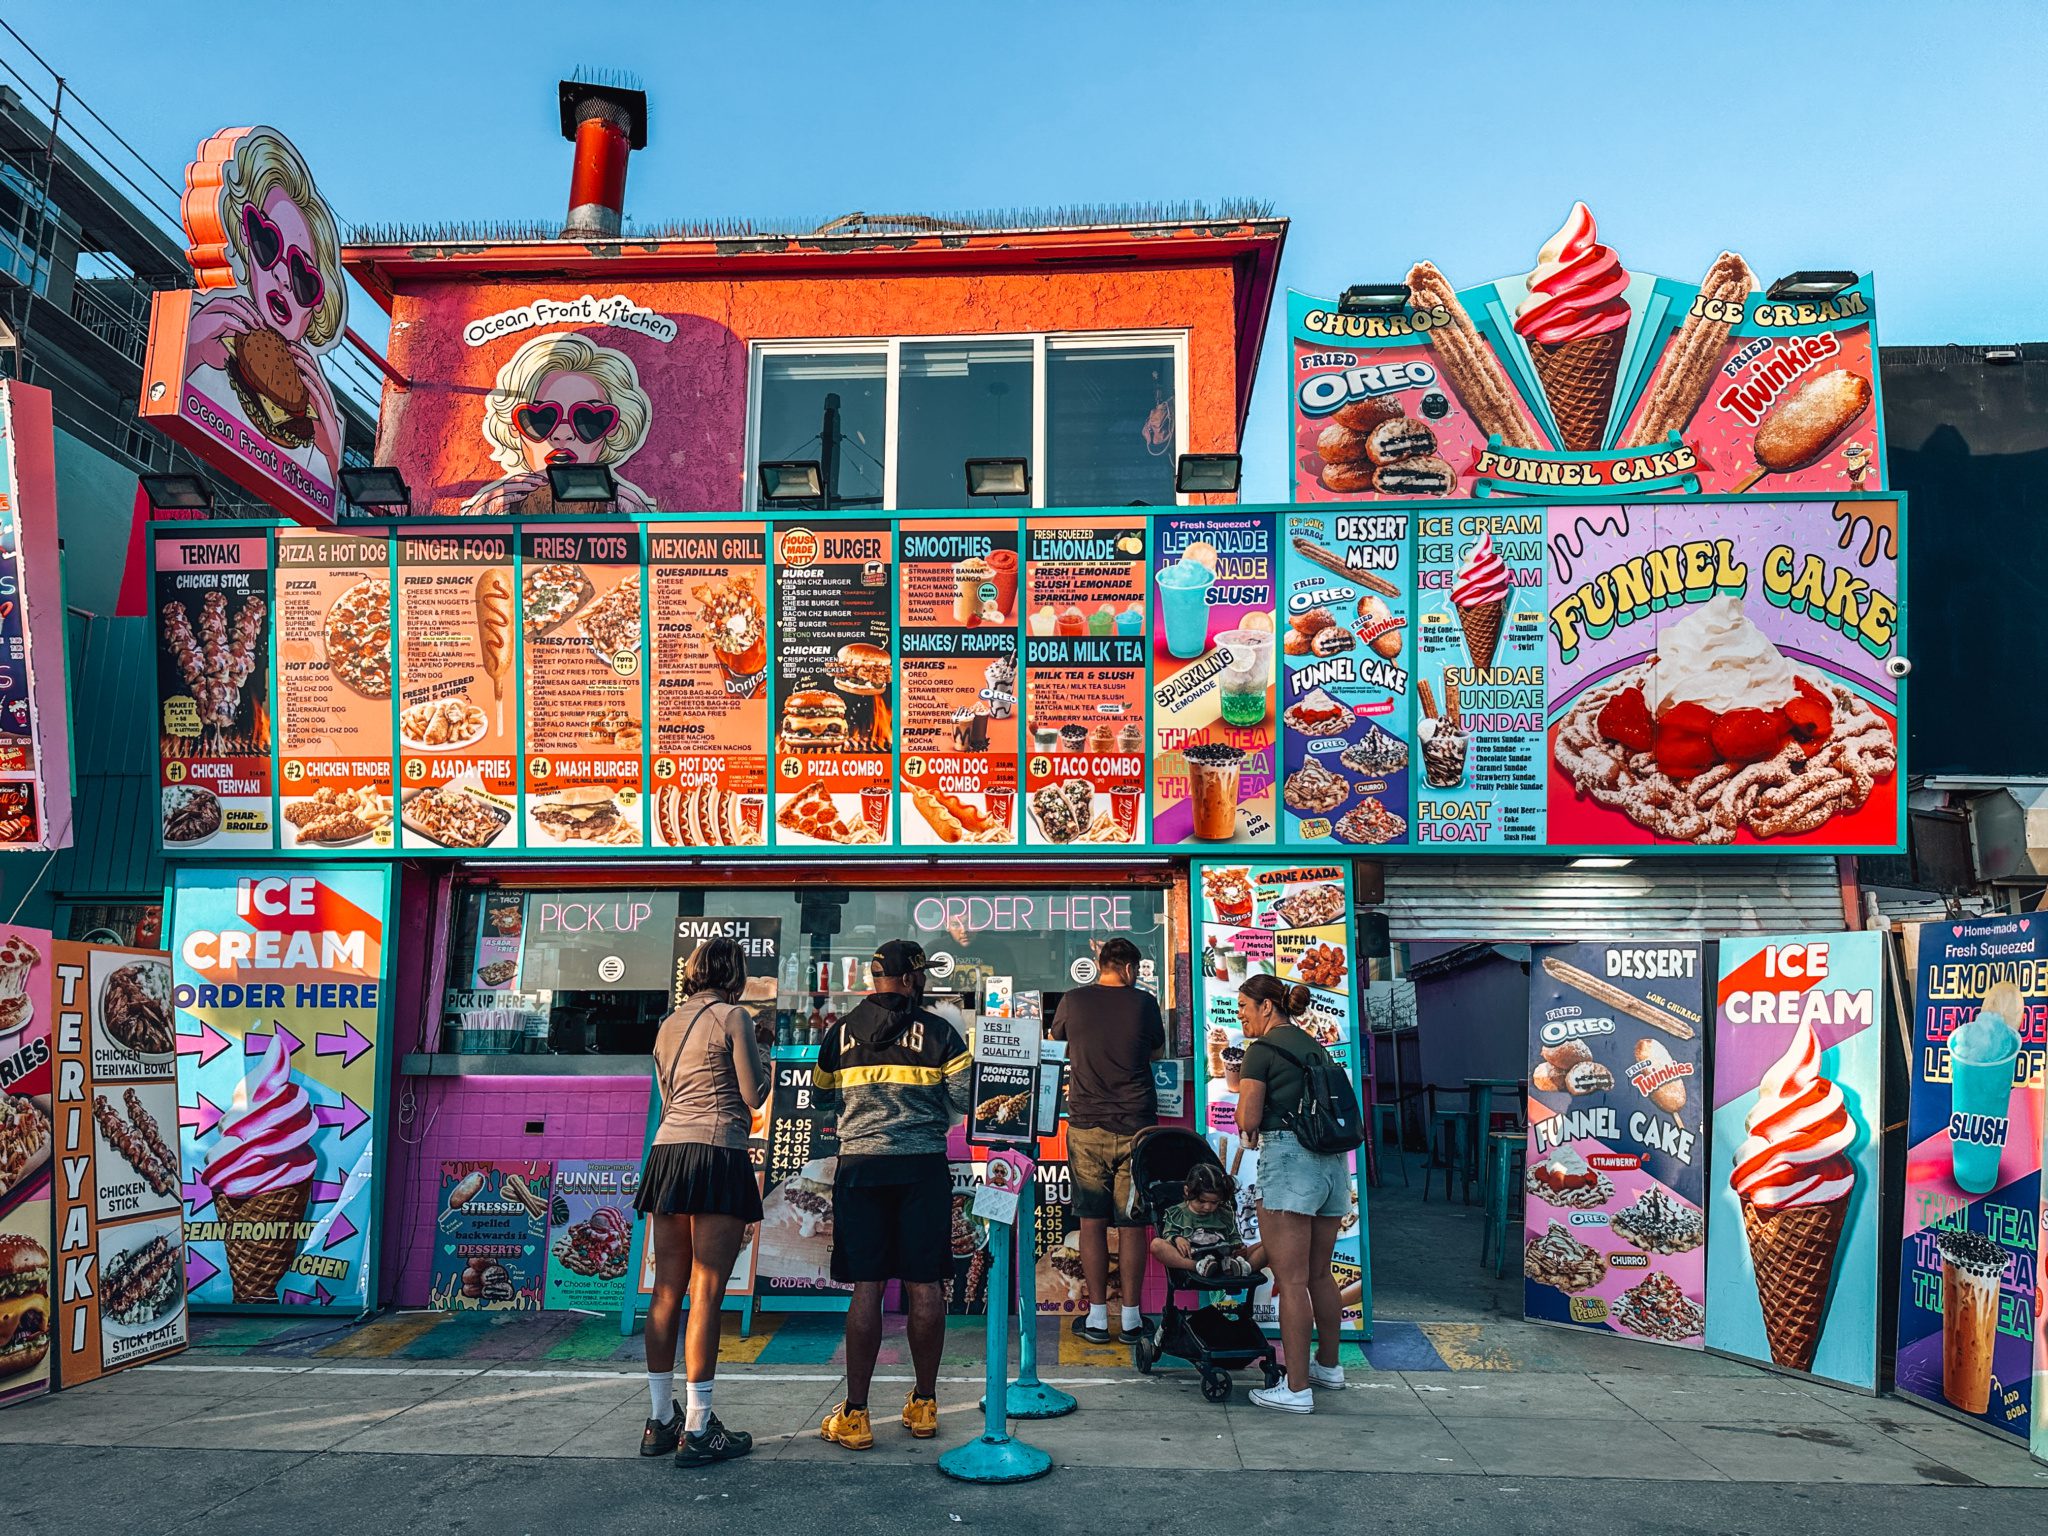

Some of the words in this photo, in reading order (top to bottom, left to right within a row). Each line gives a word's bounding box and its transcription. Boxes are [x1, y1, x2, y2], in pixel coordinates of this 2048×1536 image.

[1692, 296, 1747, 323] ICE
[1752, 292, 1868, 327] CREAM
[469, 310, 528, 341] Ocean
[536, 300, 591, 321] Front
[599, 301, 671, 336] Kitchen
[1304, 304, 1452, 338] CHURROS
[1301, 352, 1357, 369] FRIED
[1723, 336, 1772, 378] FRIED
[1301, 362, 1435, 410] OREO
[1720, 333, 1838, 425] Twinkies
[187, 395, 234, 440] Ocean
[240, 430, 277, 471] Front
[283, 462, 329, 508] Kitchen
[1476, 452, 1601, 486] FUNNEL
[1611, 448, 1696, 483] CAKE
[1180, 521, 1204, 529] Fresh
[1207, 520, 1250, 529] Squeezed
[1336, 516, 1408, 540] DESSERT
[1417, 518, 1453, 537] ICE
[1459, 515, 1541, 536] CREAM
[784, 536, 815, 545] HOUSE
[1034, 531, 1055, 539] FRESH
[1058, 530, 1093, 539] SQUEEZED
[180, 545, 240, 564] TERIYAKI
[279, 545, 314, 562] PIZZA
[319, 545, 326, 561] &
[332, 545, 356, 562] HOT
[360, 544, 386, 562] DOG
[406, 539, 458, 560] FINGER
[463, 539, 505, 559] FOOD
[534, 537, 581, 560] FRIES/
[588, 538, 627, 559] TOTS
[652, 539, 717, 559] MEXICAN
[722, 540, 762, 558] GRILL
[823, 539, 881, 558] BURGER
[905, 537, 991, 557] SMOOTHIES
[1033, 540, 1114, 560] LEMONADE
[787, 556, 813, 564] PATTY
[1346, 546, 1397, 569] MENU
[176, 574, 218, 589] CHICKEN
[220, 574, 249, 587] STICK
[405, 577, 433, 585] FRIED
[436, 577, 473, 585] SNACK
[656, 569, 728, 577] QUESADILLAS
[1034, 594, 1088, 602] SPARKLING
[1206, 586, 1269, 605] SLUSH
[1289, 588, 1355, 612] OREO
[1550, 539, 1747, 660] FUNNEL
[1763, 544, 1898, 656] CAKE
[1518, 613, 1538, 621] Flavor
[1357, 617, 1405, 644] Twinkies
[903, 634, 958, 652] SHAKES/
[962, 634, 1014, 651] FRAPPES
[1029, 643, 1067, 661] BOBA
[1074, 642, 1112, 661] MILK
[1114, 642, 1143, 661] TEA
[285, 662, 306, 670] HOT
[309, 662, 330, 670] DOG
[1155, 648, 1234, 708] SPARKLING
[1446, 666, 1543, 686] SUNDAE
[191, 764, 233, 778] CHICKEN
[307, 762, 349, 776] CHICKEN
[352, 762, 390, 776] TENDER
[431, 760, 474, 778] ASADA
[477, 760, 510, 778] FRIES
[556, 761, 591, 776] SMASH
[596, 761, 638, 776] BURGER
[679, 758, 702, 770] HOT
[704, 758, 725, 771] DOG
[808, 761, 839, 776] PIZZA
[842, 761, 883, 776] COMBO
[928, 758, 961, 774] CORN
[963, 758, 988, 774] DOG
[1053, 758, 1087, 775] TACO
[1092, 757, 1141, 776] COMBO
[217, 780, 260, 793] TERIYAKI
[681, 773, 717, 787] COMBO
[939, 776, 979, 792] COMBO
[227, 812, 257, 820] CHAR-
[1418, 802, 1491, 820] FLOAT
[1259, 872, 1298, 884] CARNE
[1301, 869, 1338, 882] ASADA
[237, 877, 316, 916] ICE
[541, 904, 606, 932] PICK
[615, 903, 651, 932] UP
[914, 897, 1033, 931] ORDER
[1049, 895, 1131, 930] HERE
[678, 922, 749, 938] SMASH
[1235, 934, 1273, 942] Strawberry
[1965, 923, 2018, 937] Home-made
[1277, 935, 1316, 945] BUFFALO
[1946, 944, 1977, 957] Fresh
[1980, 939, 2035, 958] Squeezed
[182, 930, 365, 969] CREAM
[1282, 947, 1304, 955] Wings
[1606, 948, 1696, 979] DESSERT
[1765, 942, 1829, 978] ICE
[174, 983, 285, 1008] ORDER
[296, 983, 377, 1008] HERE
[1546, 1006, 1582, 1020] FRIED
[1725, 989, 1873, 1026] CREAM
[984, 1022, 1002, 1031] YES
[1541, 1017, 1615, 1044] OREO
[983, 1036, 1020, 1045] BETTER
[95, 1050, 140, 1061] CHICKEN
[983, 1047, 1022, 1058] QUALITY
[96, 1064, 141, 1075] TERIYAKI
[144, 1063, 172, 1074] BOWL
[983, 1066, 1029, 1076] MONSTER
[981, 1075, 1007, 1083] CORN
[1010, 1077, 1030, 1085] DOG
[1632, 1062, 1693, 1097] Twinkies
[776, 1118, 811, 1131] $4.95
[1950, 1113, 2009, 1146] SLUSH
[775, 1131, 810, 1144] $4.95
[1535, 1108, 1620, 1153] FUNNEL
[1629, 1113, 1695, 1166] CAKE
[55, 964, 97, 1353] TERIYAKI
[774, 1144, 809, 1157] $4.95
[1592, 1156, 1638, 1167] STRAWBERRY
[100, 1182, 146, 1199] CHICKEN
[109, 1197, 139, 1212] STICK
[462, 1203, 525, 1213] STRESSED
[472, 1219, 510, 1228] spelled
[456, 1231, 515, 1240] backwards
[518, 1231, 527, 1239] is
[459, 1245, 521, 1255] DESSERTS
[113, 1332, 150, 1353] STICK
[147, 1324, 177, 1344] PLATE
[2004, 1391, 2019, 1405] ADD
[2007, 1404, 2027, 1420] BOBA
